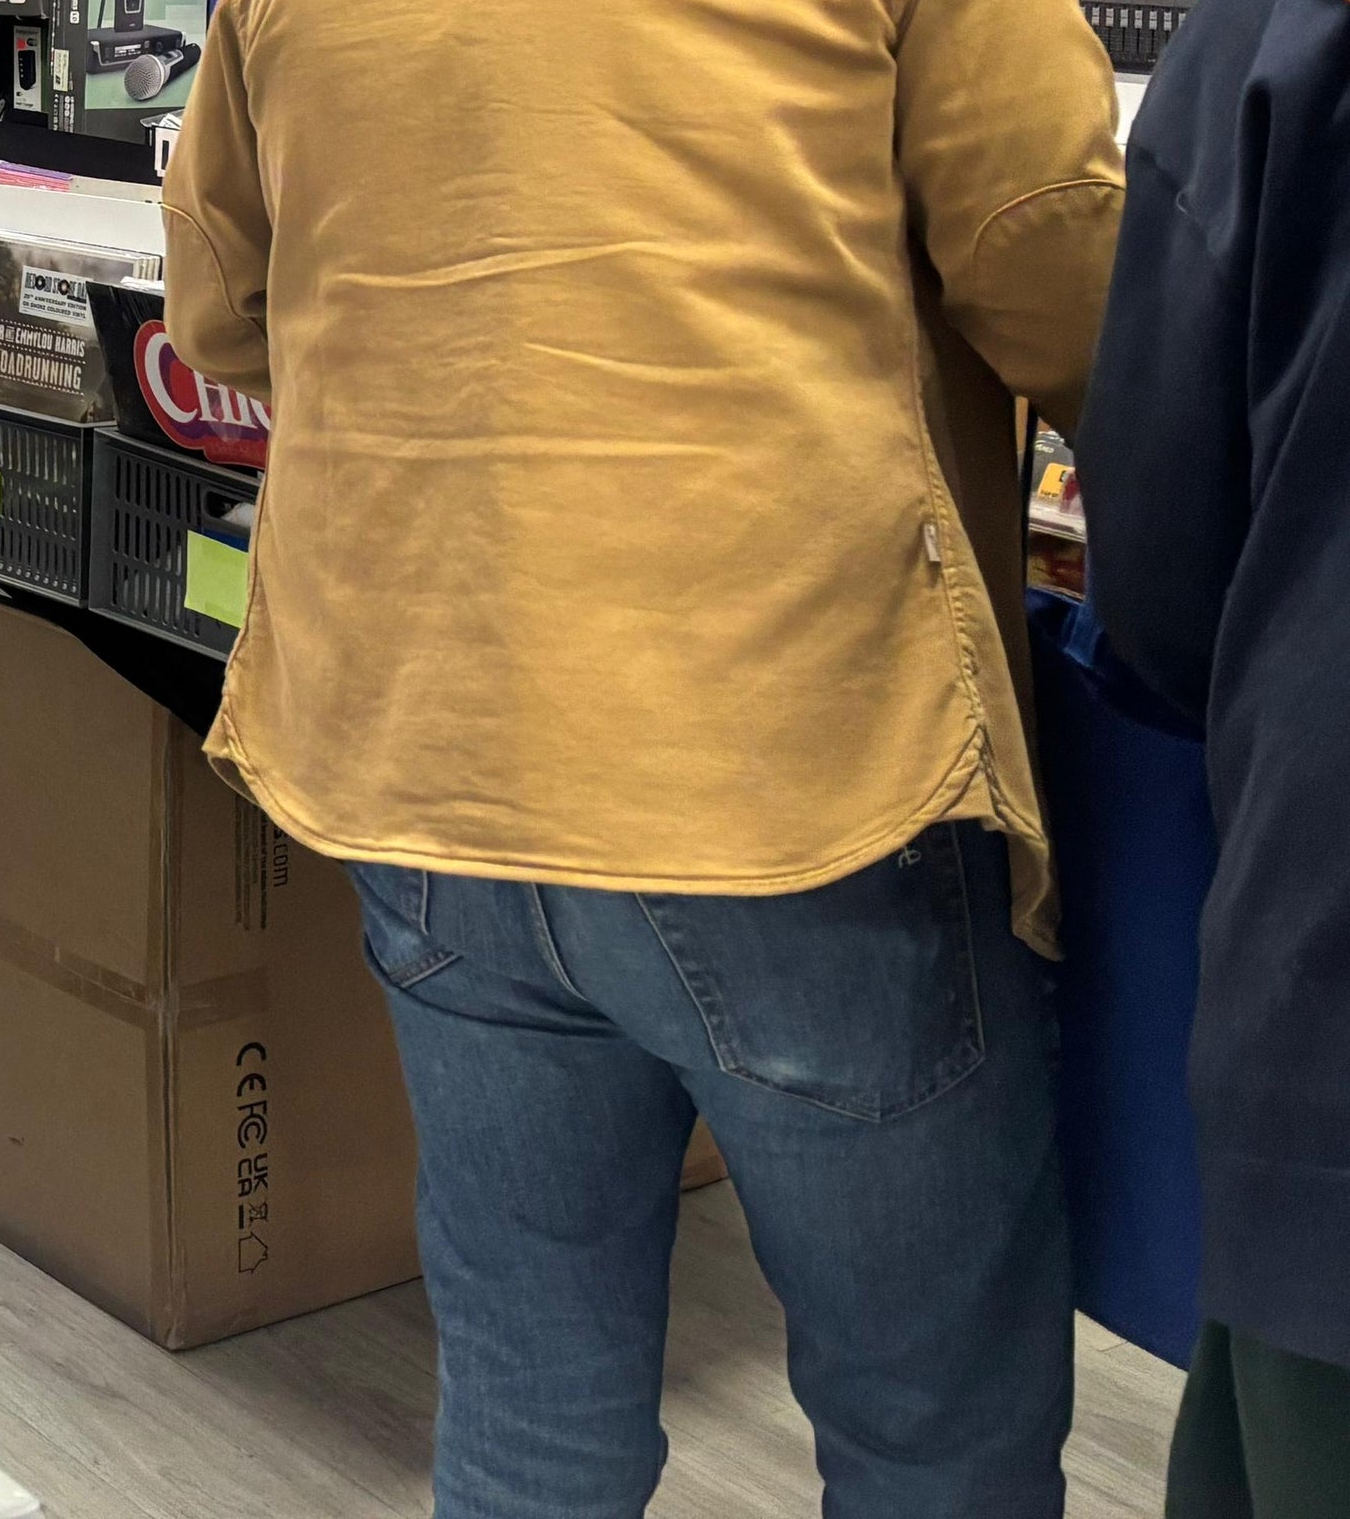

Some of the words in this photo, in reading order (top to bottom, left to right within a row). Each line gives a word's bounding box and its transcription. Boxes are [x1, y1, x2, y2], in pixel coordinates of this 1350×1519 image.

[34, 296, 66, 306] ANNIVERSARY
[68, 302, 86, 310] EDITION
[47, 306, 71, 316] COLOURED
[15, 328, 53, 350] EMMYLOU
[55, 336, 86, 358] HARRIS
